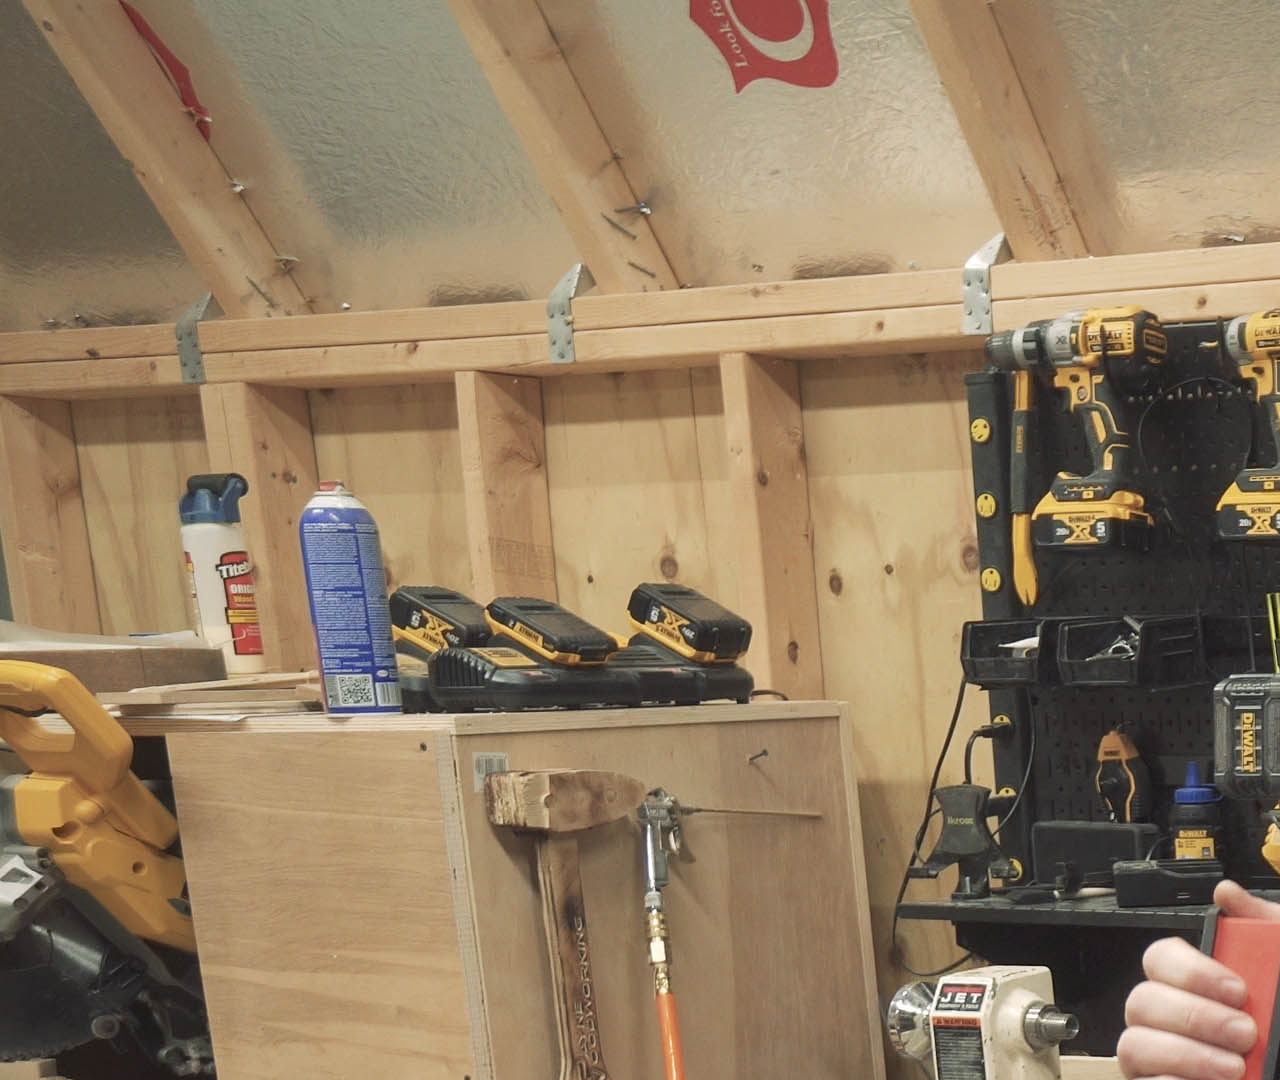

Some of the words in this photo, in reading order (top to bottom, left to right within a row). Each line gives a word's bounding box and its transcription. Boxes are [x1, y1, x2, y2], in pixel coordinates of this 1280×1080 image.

[720, 20, 749, 67] Look
[1087, 329, 1123, 342] DEALT
[1242, 712, 1256, 773] DEWALT
[940, 991, 983, 1004] JET
